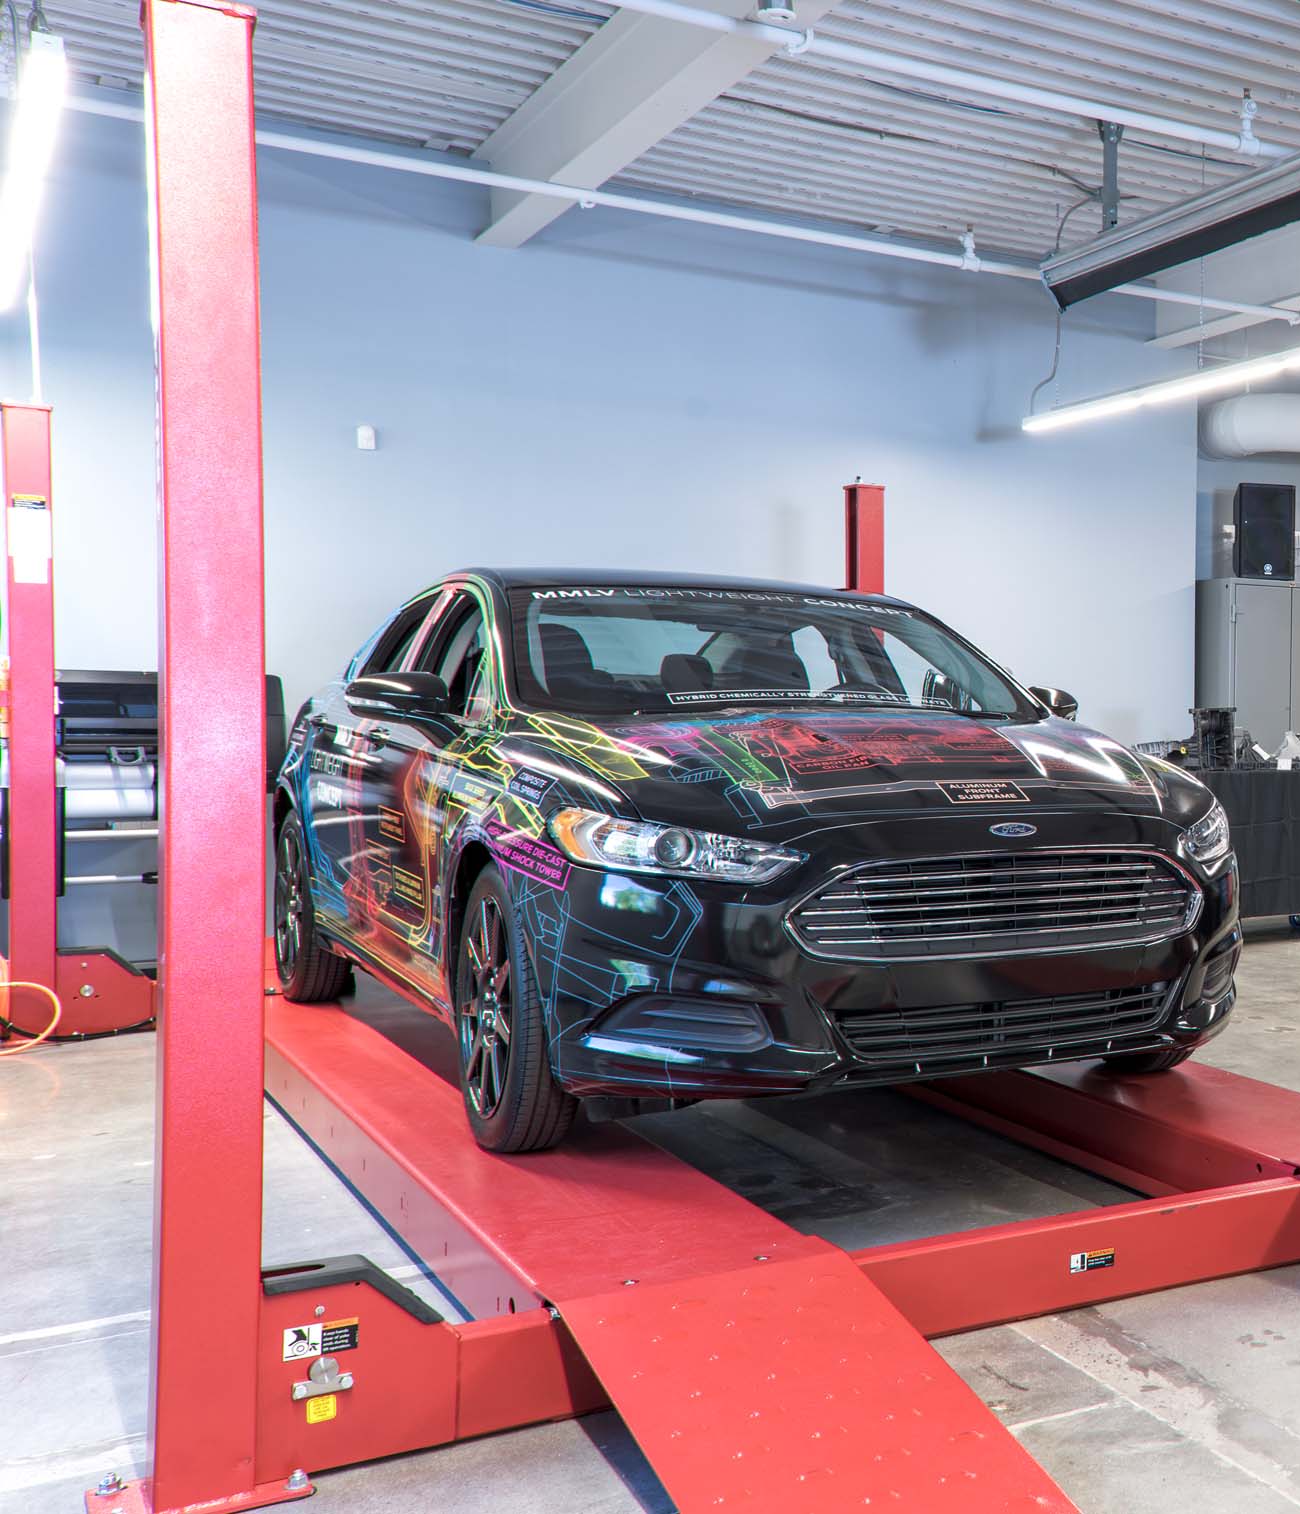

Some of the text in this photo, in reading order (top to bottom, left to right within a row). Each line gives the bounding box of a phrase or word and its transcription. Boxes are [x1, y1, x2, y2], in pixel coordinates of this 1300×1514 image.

[532, 589, 913, 618] MMLV LIGHTWEIGHT CONCEPT
[519, 772, 548, 789] COMPOSITE
[511, 848, 535, 869] SHOCK
[535, 864, 563, 881] TOWER
[533, 847, 567, 868] DIE-CAST
